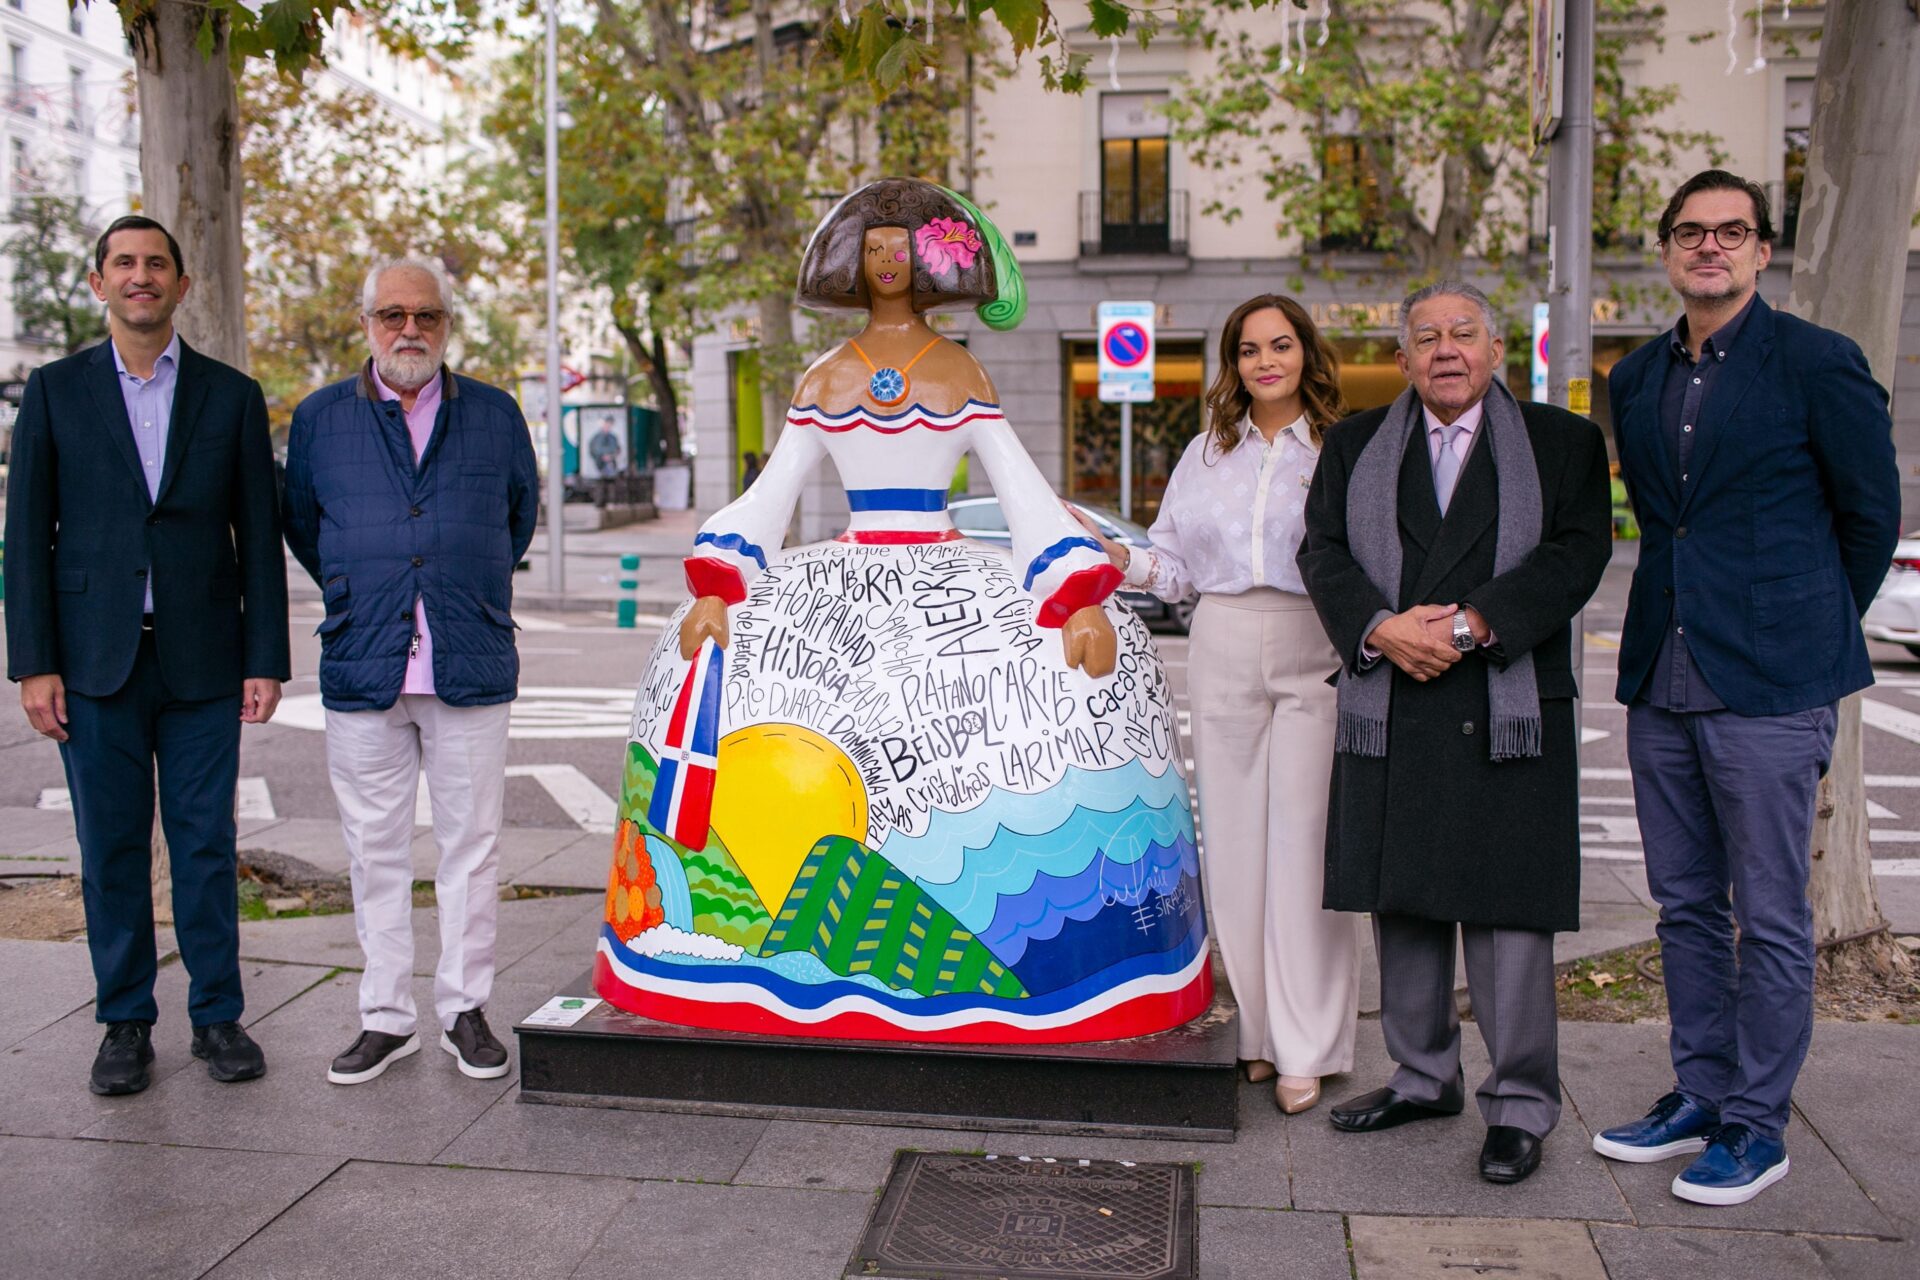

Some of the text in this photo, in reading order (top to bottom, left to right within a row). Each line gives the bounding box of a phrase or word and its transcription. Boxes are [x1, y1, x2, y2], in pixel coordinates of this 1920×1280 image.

[797, 558, 903, 606] TAMBORA
[736, 611, 769, 630] de
[769, 682, 839, 731] DUARTE
[828, 714, 891, 796] DOMINICANA
[868, 797, 913, 844] PLAYAS
